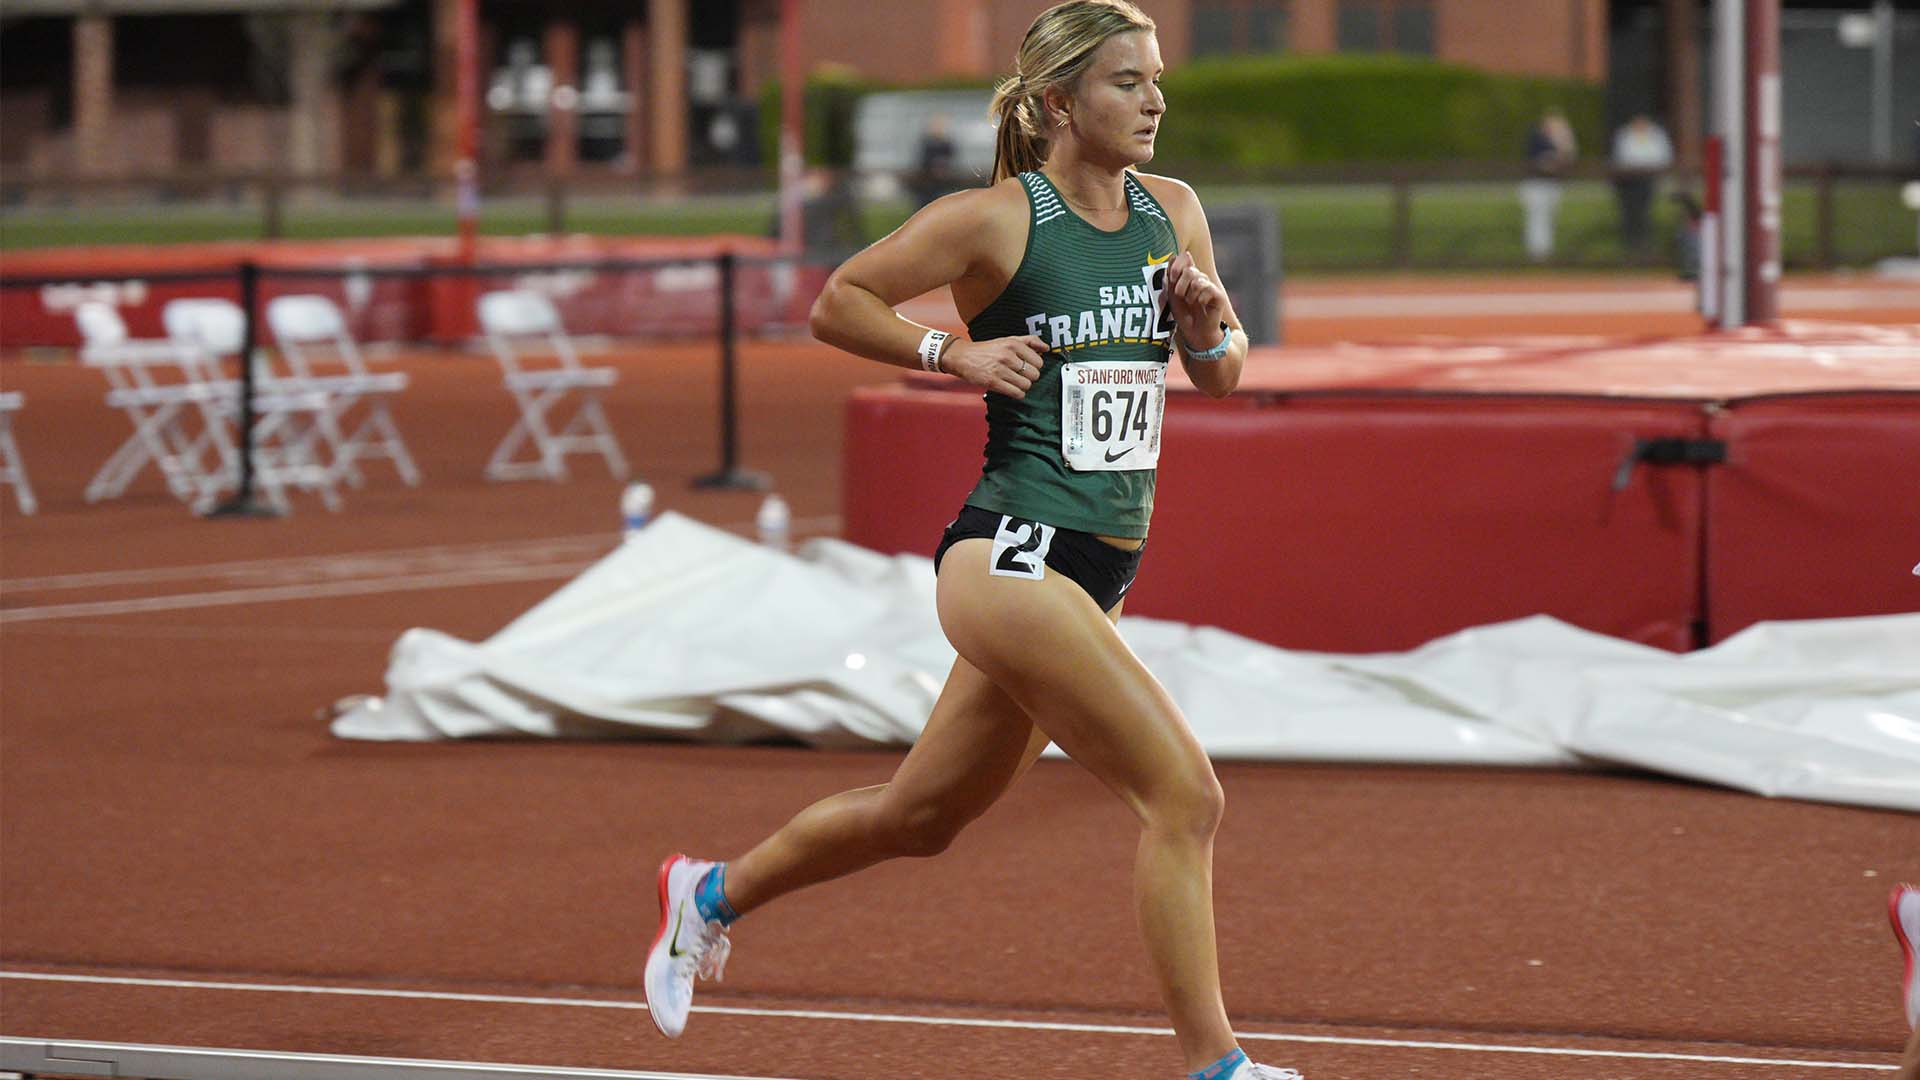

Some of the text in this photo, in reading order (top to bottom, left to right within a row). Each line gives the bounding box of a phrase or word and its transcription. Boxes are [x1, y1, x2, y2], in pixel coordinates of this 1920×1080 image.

[1099, 284, 1150, 306] SAN
[1078, 368, 1158, 385] STANFORD INVITE
[1091, 390, 1148, 442] 674
[995, 516, 1042, 574] 2
